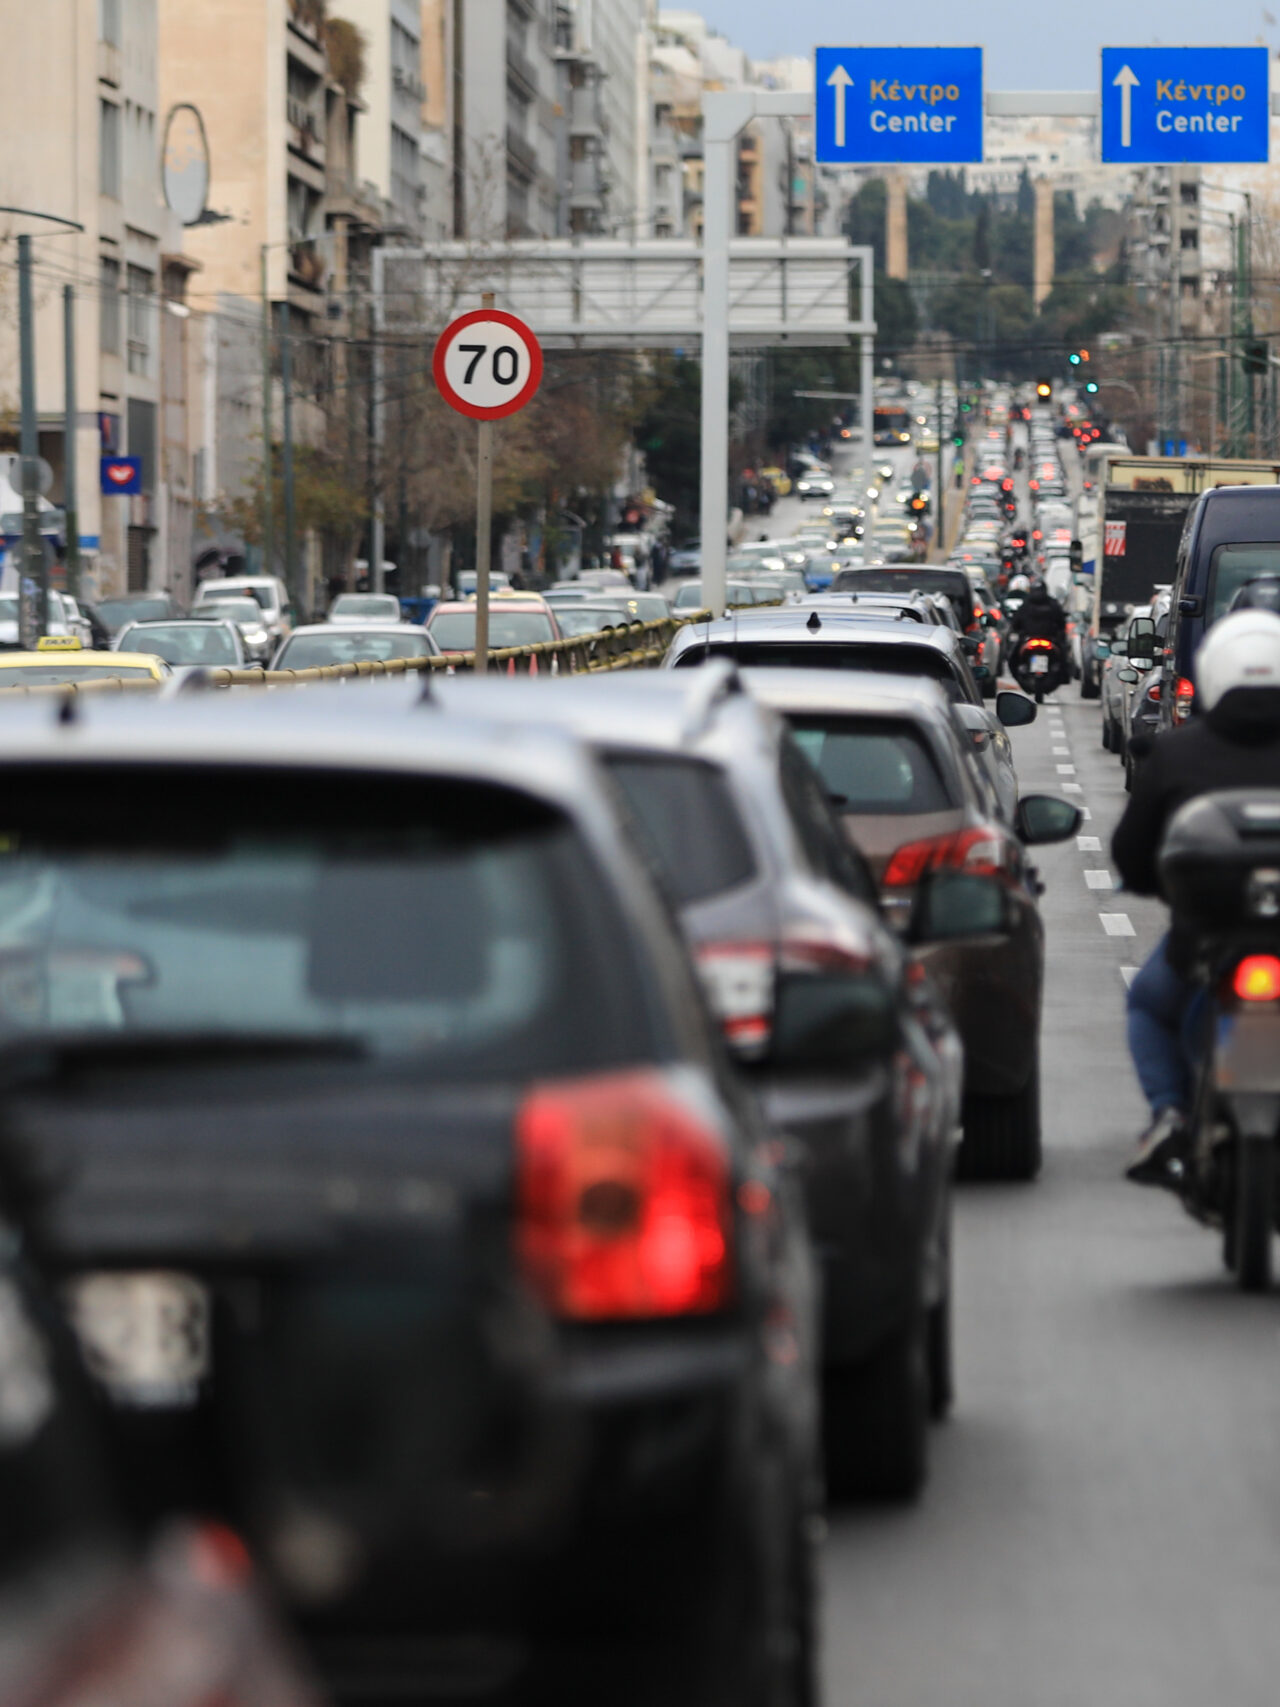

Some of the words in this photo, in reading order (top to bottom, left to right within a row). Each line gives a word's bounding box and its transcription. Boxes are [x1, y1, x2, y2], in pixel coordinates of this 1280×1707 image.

[869, 79, 960, 106] Κέντρο
[1155, 79, 1246, 106] Κέντρο
[869, 110, 957, 133] Center
[1155, 110, 1243, 133] Center
[458, 344, 519, 386] 70
